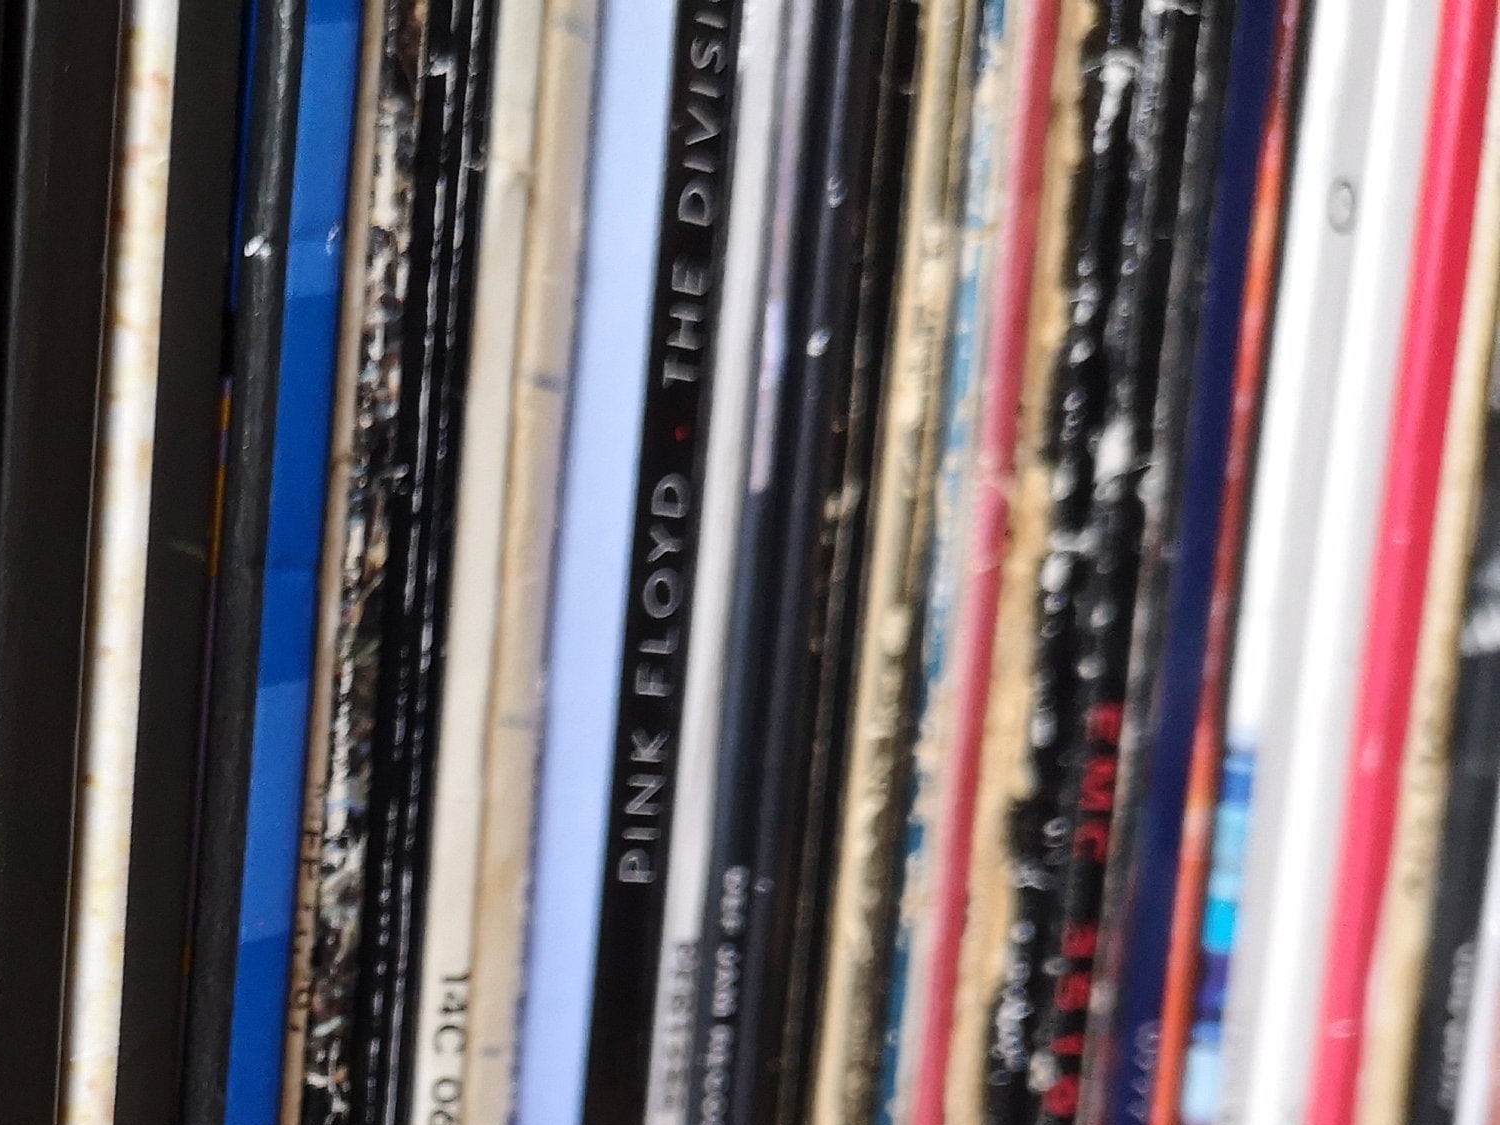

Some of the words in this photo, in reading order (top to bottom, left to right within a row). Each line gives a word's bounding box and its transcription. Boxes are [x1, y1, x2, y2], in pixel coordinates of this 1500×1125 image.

[677, 0, 728, 227] DIVISI
[662, 256, 706, 389] THE
[634, 472, 692, 697] FLOYD
[617, 728, 671, 884] PINK
